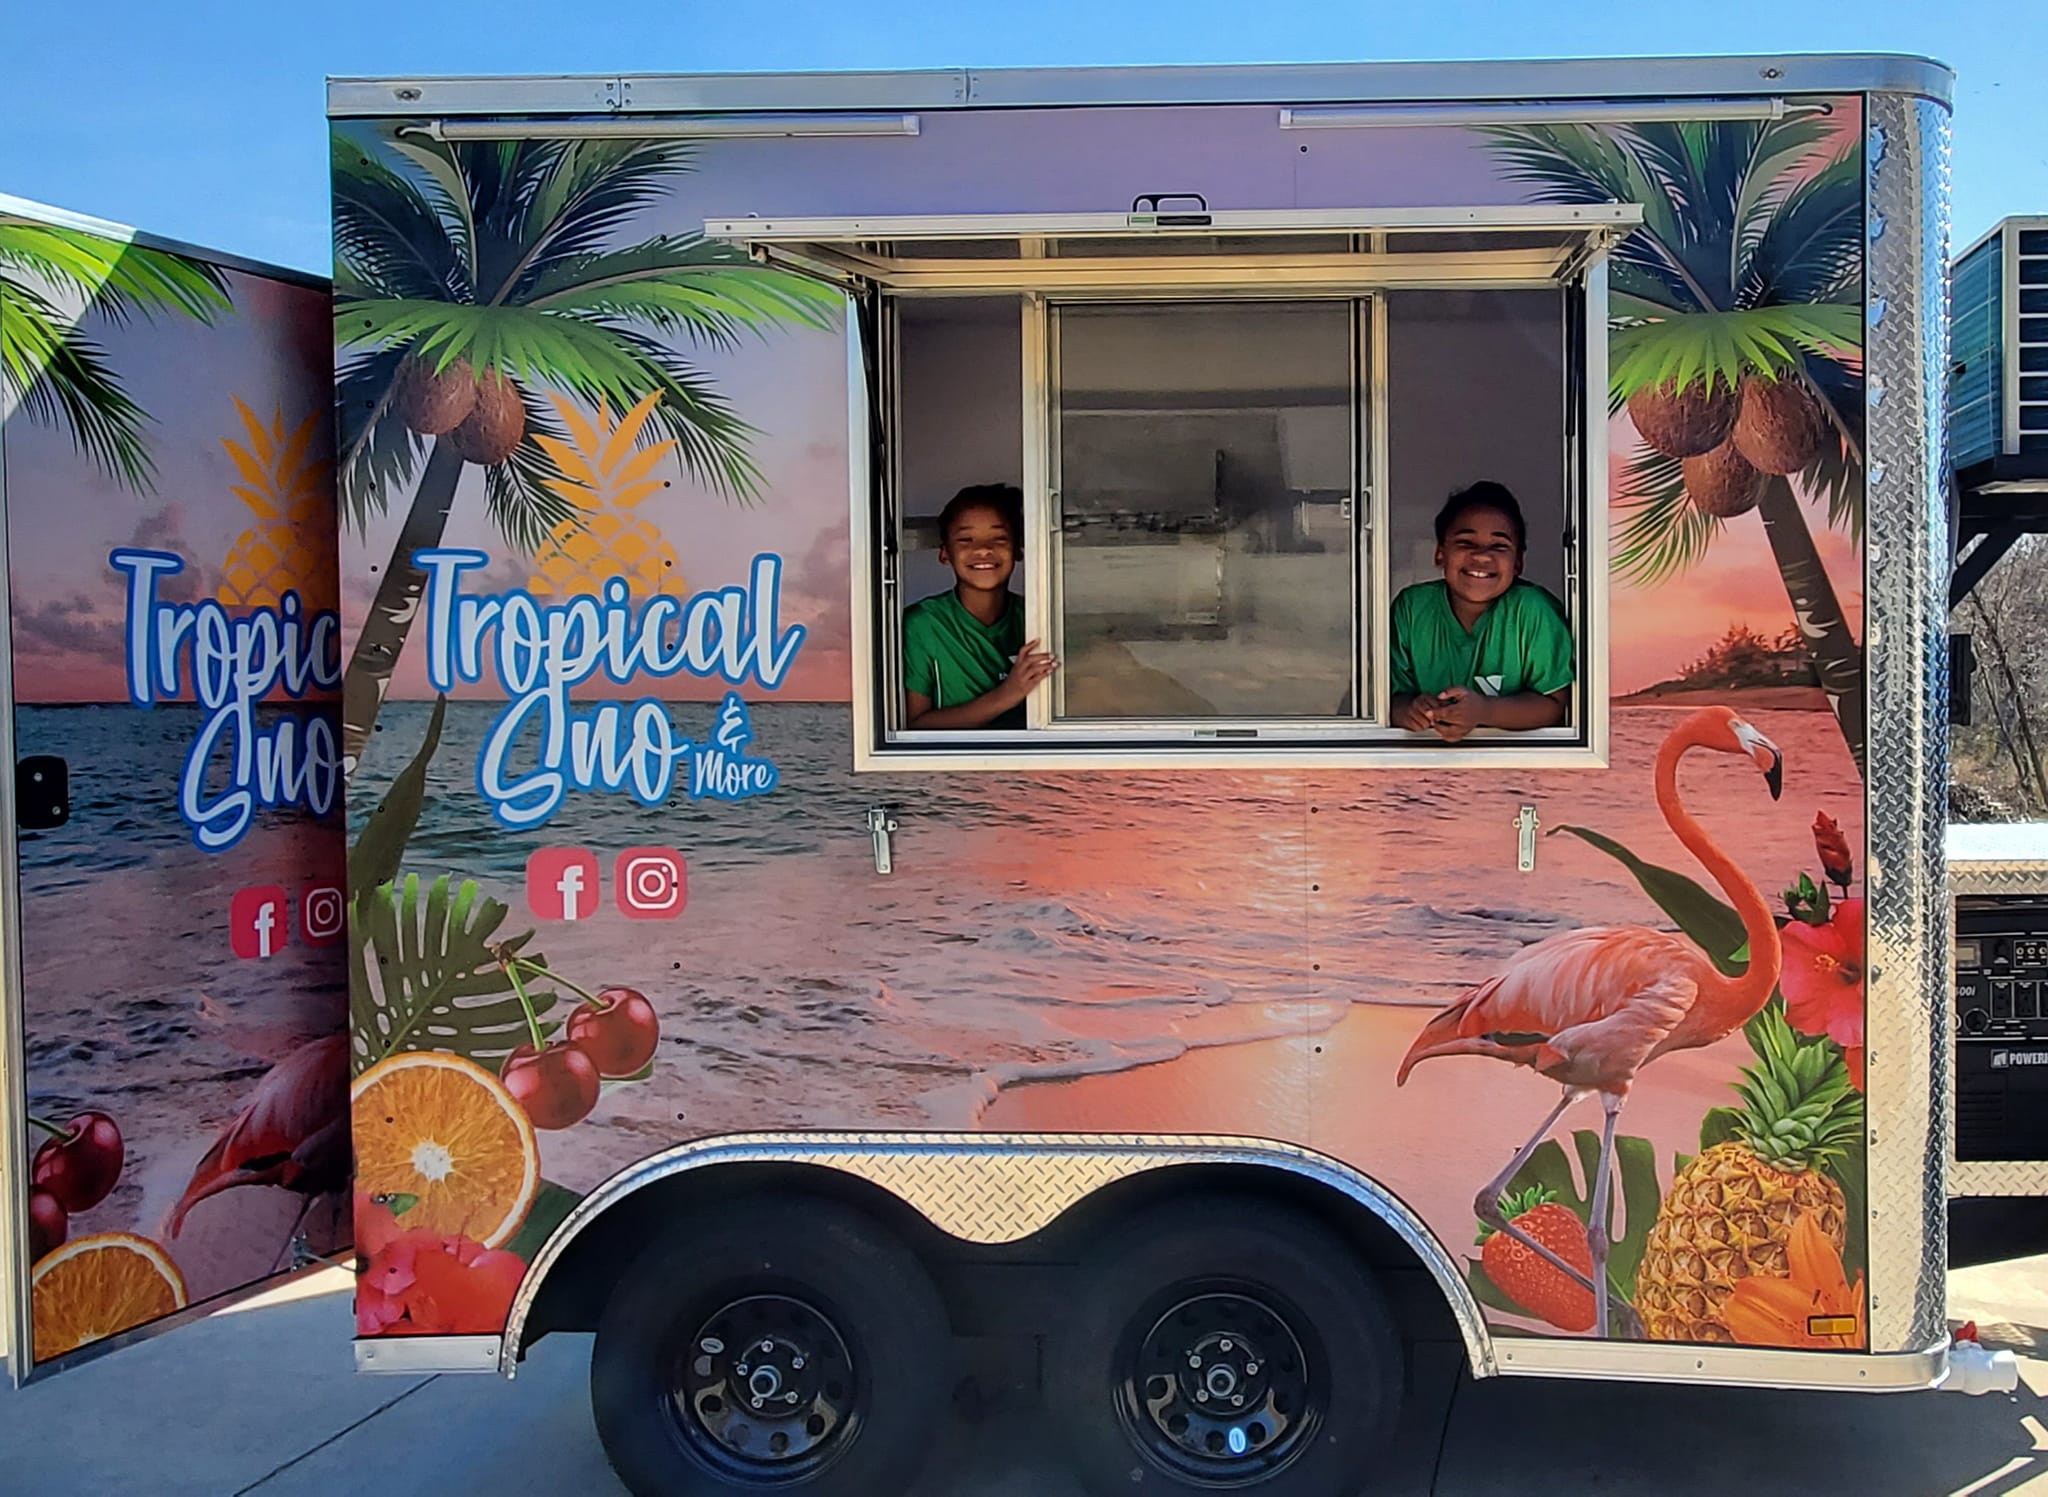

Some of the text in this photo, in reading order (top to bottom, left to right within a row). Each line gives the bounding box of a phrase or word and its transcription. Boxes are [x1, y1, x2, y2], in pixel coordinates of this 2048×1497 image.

[412, 549, 806, 696] Tropical
[180, 698, 345, 853] Sno
[477, 686, 692, 828] Sno
[692, 751, 774, 797] More
[715, 694, 750, 755] &
